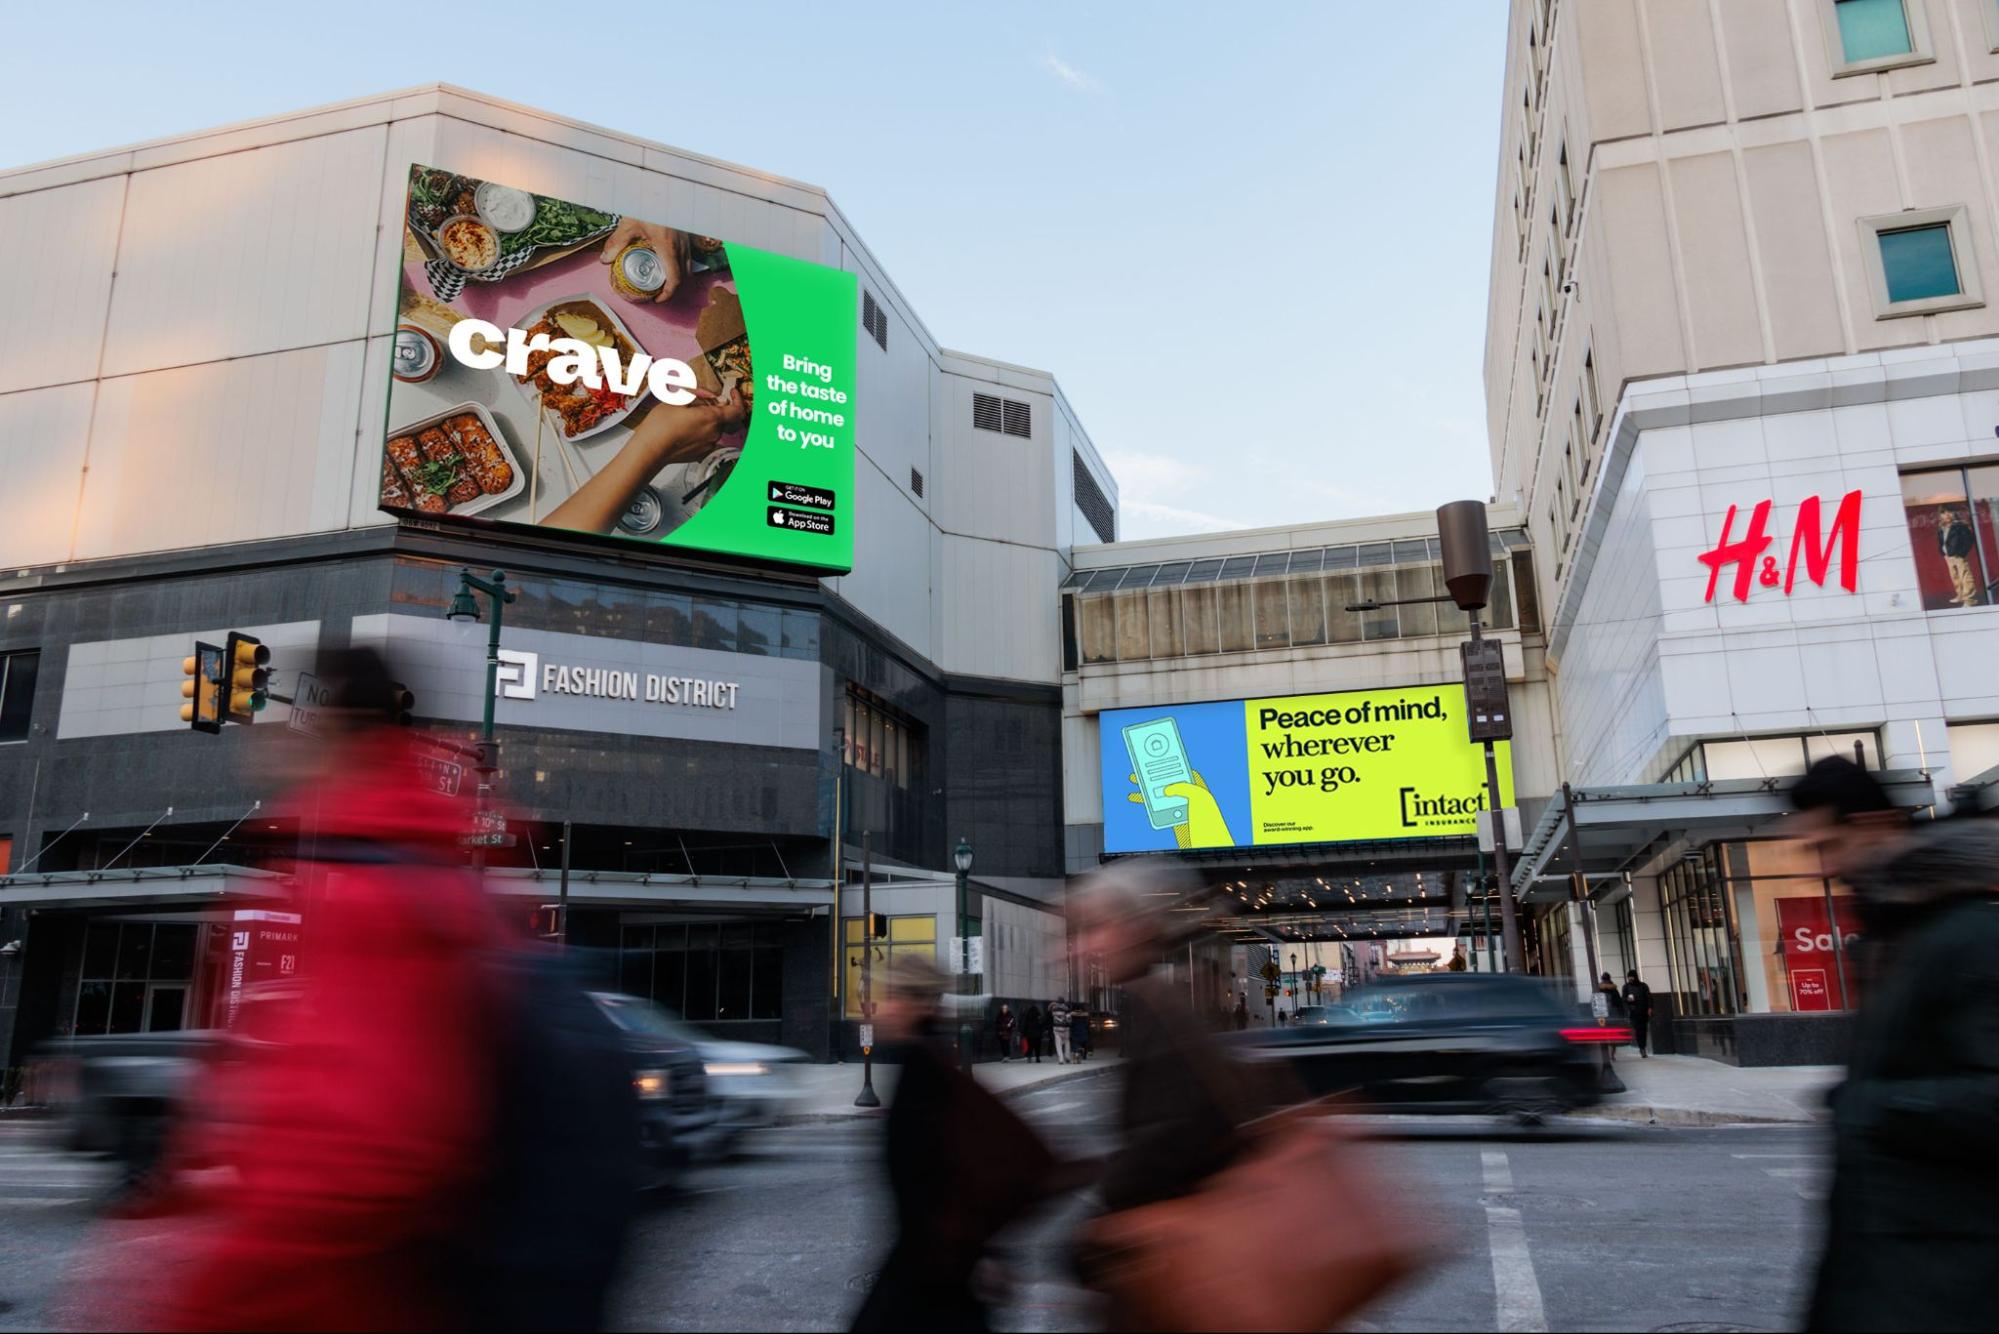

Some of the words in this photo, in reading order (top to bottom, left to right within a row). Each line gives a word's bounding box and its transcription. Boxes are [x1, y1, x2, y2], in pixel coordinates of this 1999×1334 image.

[448, 318, 698, 406] crave
[783, 354, 832, 383] Bring
[766, 374, 798, 394] the
[800, 381, 848, 404] taste
[768, 400, 788, 416] of
[789, 402, 845, 427] home
[777, 424, 797, 442] to
[800, 431, 835, 449] you
[784, 490, 814, 505] Google
[814, 495, 832, 508] Play
[788, 517, 806, 529] App
[806, 520, 830, 532] Store
[1696, 489, 1863, 605] H&M
[542, 663, 638, 700] FASHION
[644, 673, 740, 710] DISTRICT
[1260, 708, 1342, 730] Peace
[1345, 701, 1372, 724] of
[1375, 696, 1448, 722] mind,
[1260, 733, 1395, 760] wherever
[1262, 767, 1316, 796] you
[1320, 765, 1361, 793] go.
[260, 930, 298, 942] PRIMARK
[231, 951, 245, 988] FASHION
[280, 954, 295, 970] F21
